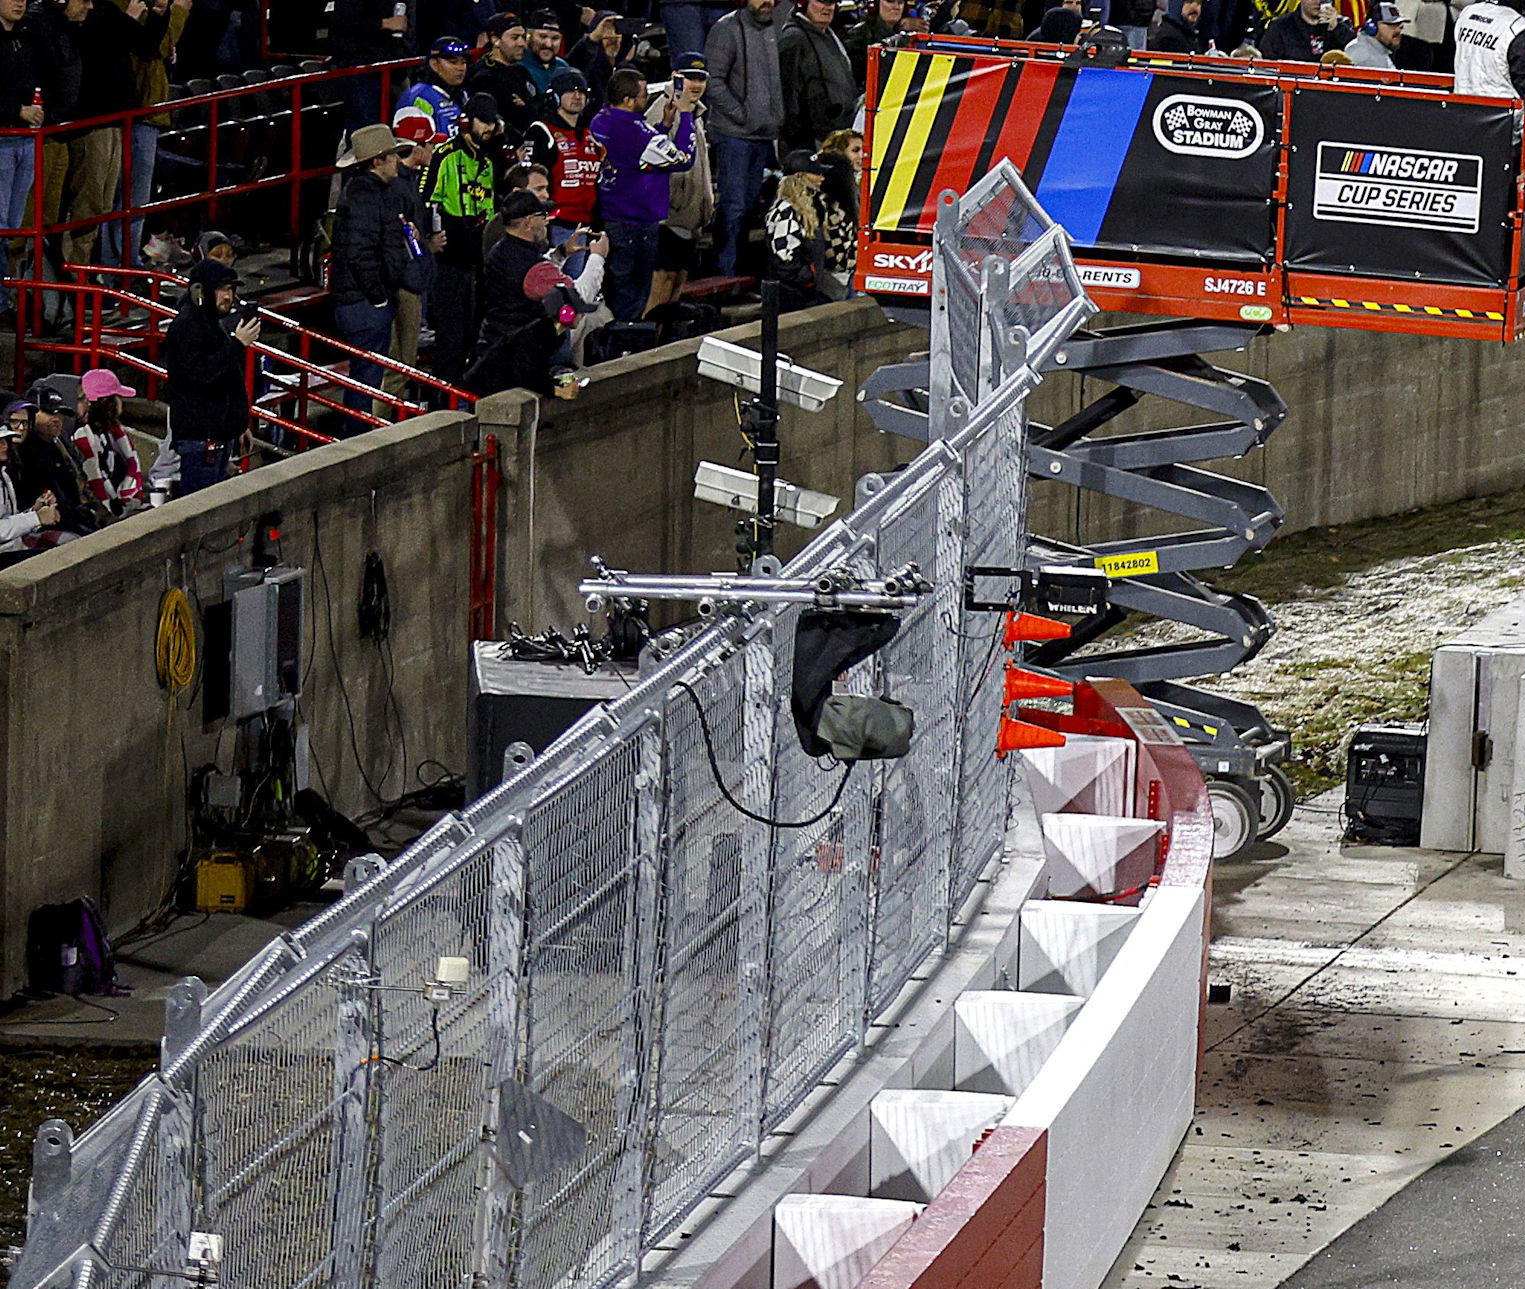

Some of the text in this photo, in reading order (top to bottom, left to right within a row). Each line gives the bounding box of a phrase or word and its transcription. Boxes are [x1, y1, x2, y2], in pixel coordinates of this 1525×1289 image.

[1187, 104, 1232, 120] BOWMAN
[1194, 117, 1224, 131] GRAY
[1172, 130, 1244, 149] STADIUM
[1368, 154, 1459, 182] NASCAR
[1337, 184, 1457, 212] CUP SERIES
[867, 280, 924, 293] ECOTRAY
[1204, 276, 1266, 296] SJ4726 E
